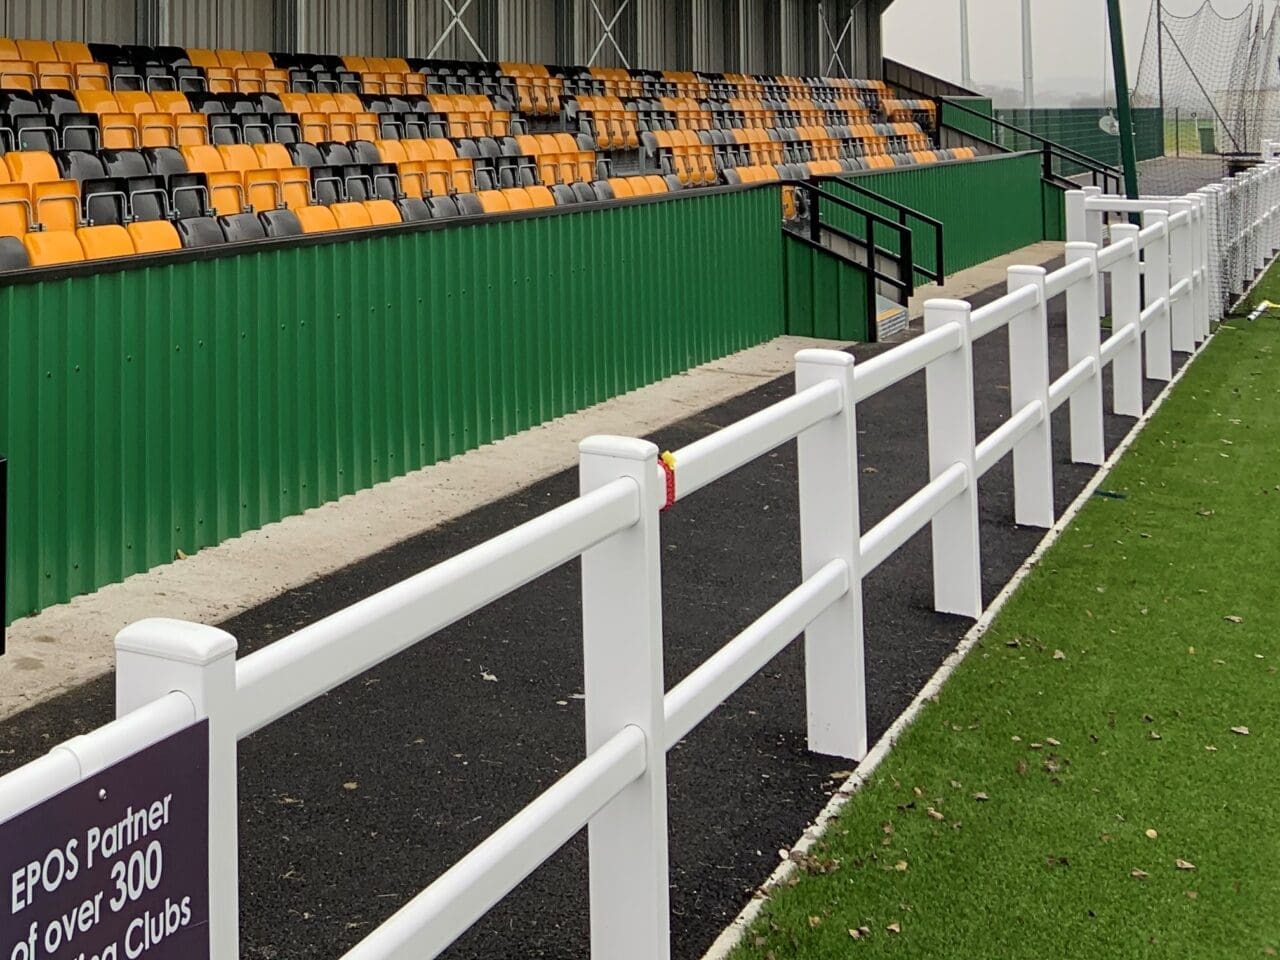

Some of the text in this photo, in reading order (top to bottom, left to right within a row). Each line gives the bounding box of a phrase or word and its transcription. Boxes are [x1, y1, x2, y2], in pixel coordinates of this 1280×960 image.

[11, 794, 172, 914] EPOS Partner
[44, 890, 104, 954] over
[109, 840, 163, 912] 300
[124, 896, 192, 960] Clubs
